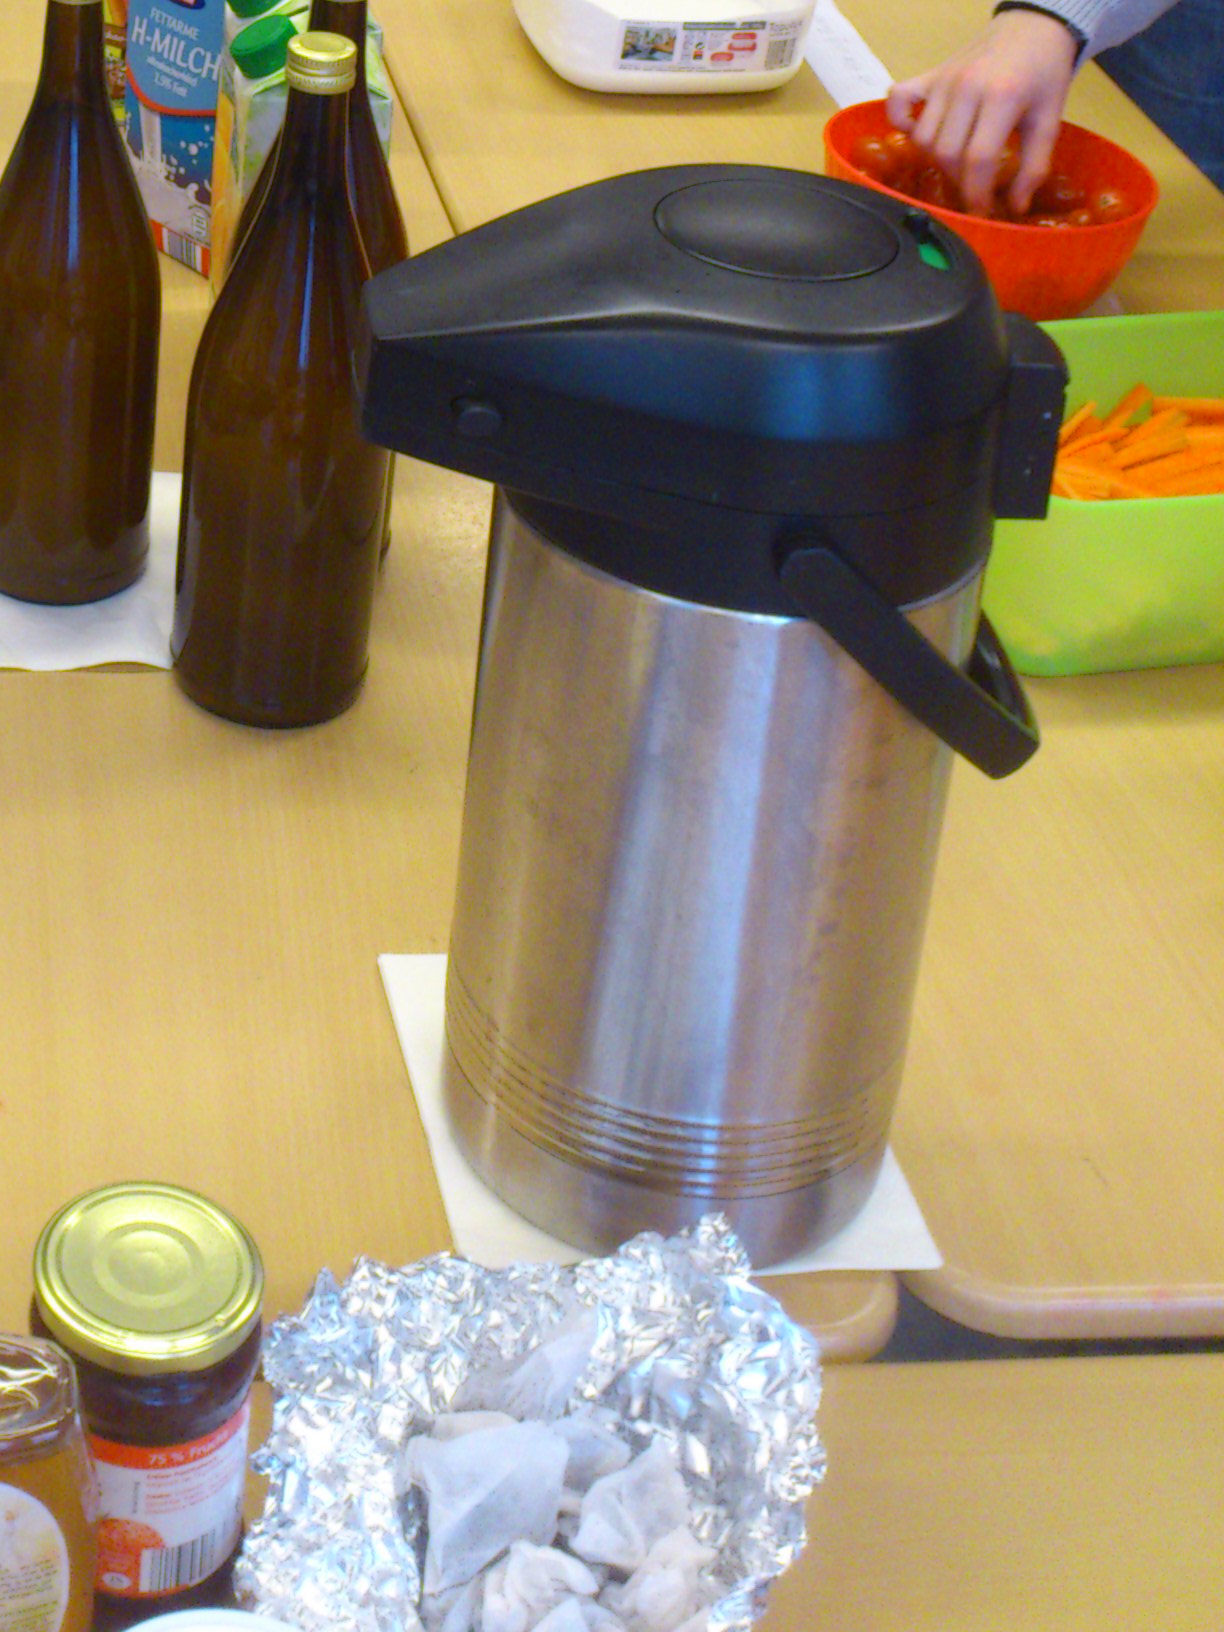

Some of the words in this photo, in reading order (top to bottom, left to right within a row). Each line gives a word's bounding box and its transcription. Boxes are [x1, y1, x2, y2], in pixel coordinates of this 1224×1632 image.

[150, 8, 200, 40] FETTARME
[131, 15, 222, 81] H-MILCH
[149, 1454, 167, 1465] 75
